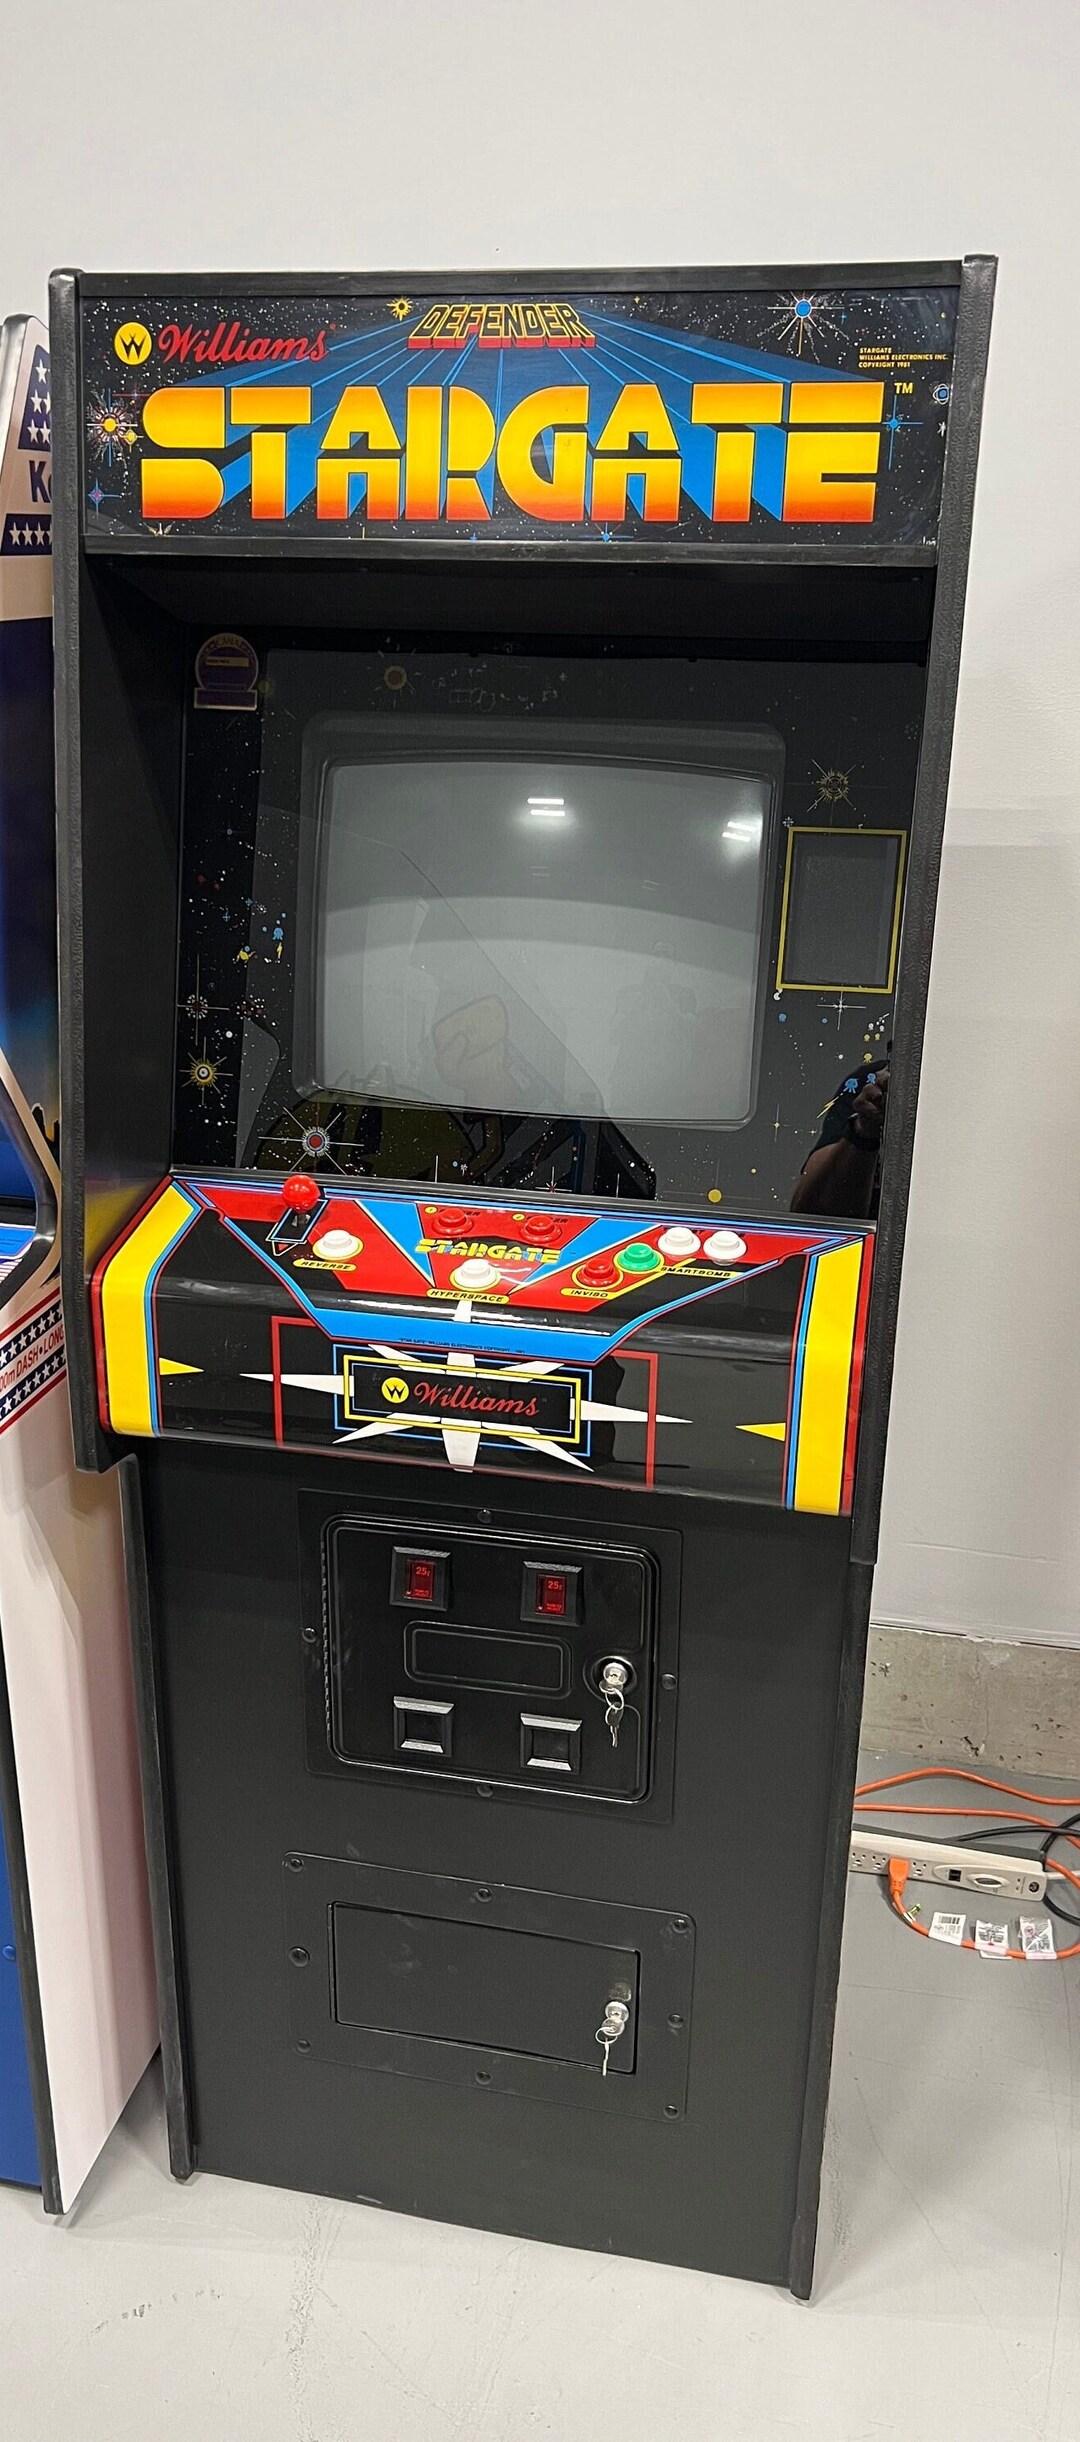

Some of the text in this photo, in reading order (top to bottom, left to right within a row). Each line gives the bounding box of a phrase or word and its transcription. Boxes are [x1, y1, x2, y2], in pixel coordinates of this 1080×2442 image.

[406, 303, 596, 349] DEFENDER
[158, 321, 330, 364] Williams
[894, 382, 914, 395] TM
[141, 382, 885, 524] STARGATE
[415, 1238, 562, 1264] STARGATE
[301, 1260, 352, 1270] REVERSE
[660, 1266, 732, 1278] SMARTBOMB
[430, 1289, 505, 1303] HYPERSPACE
[570, 1289, 609, 1298] INVISO
[413, 1382, 540, 1417] Williams
